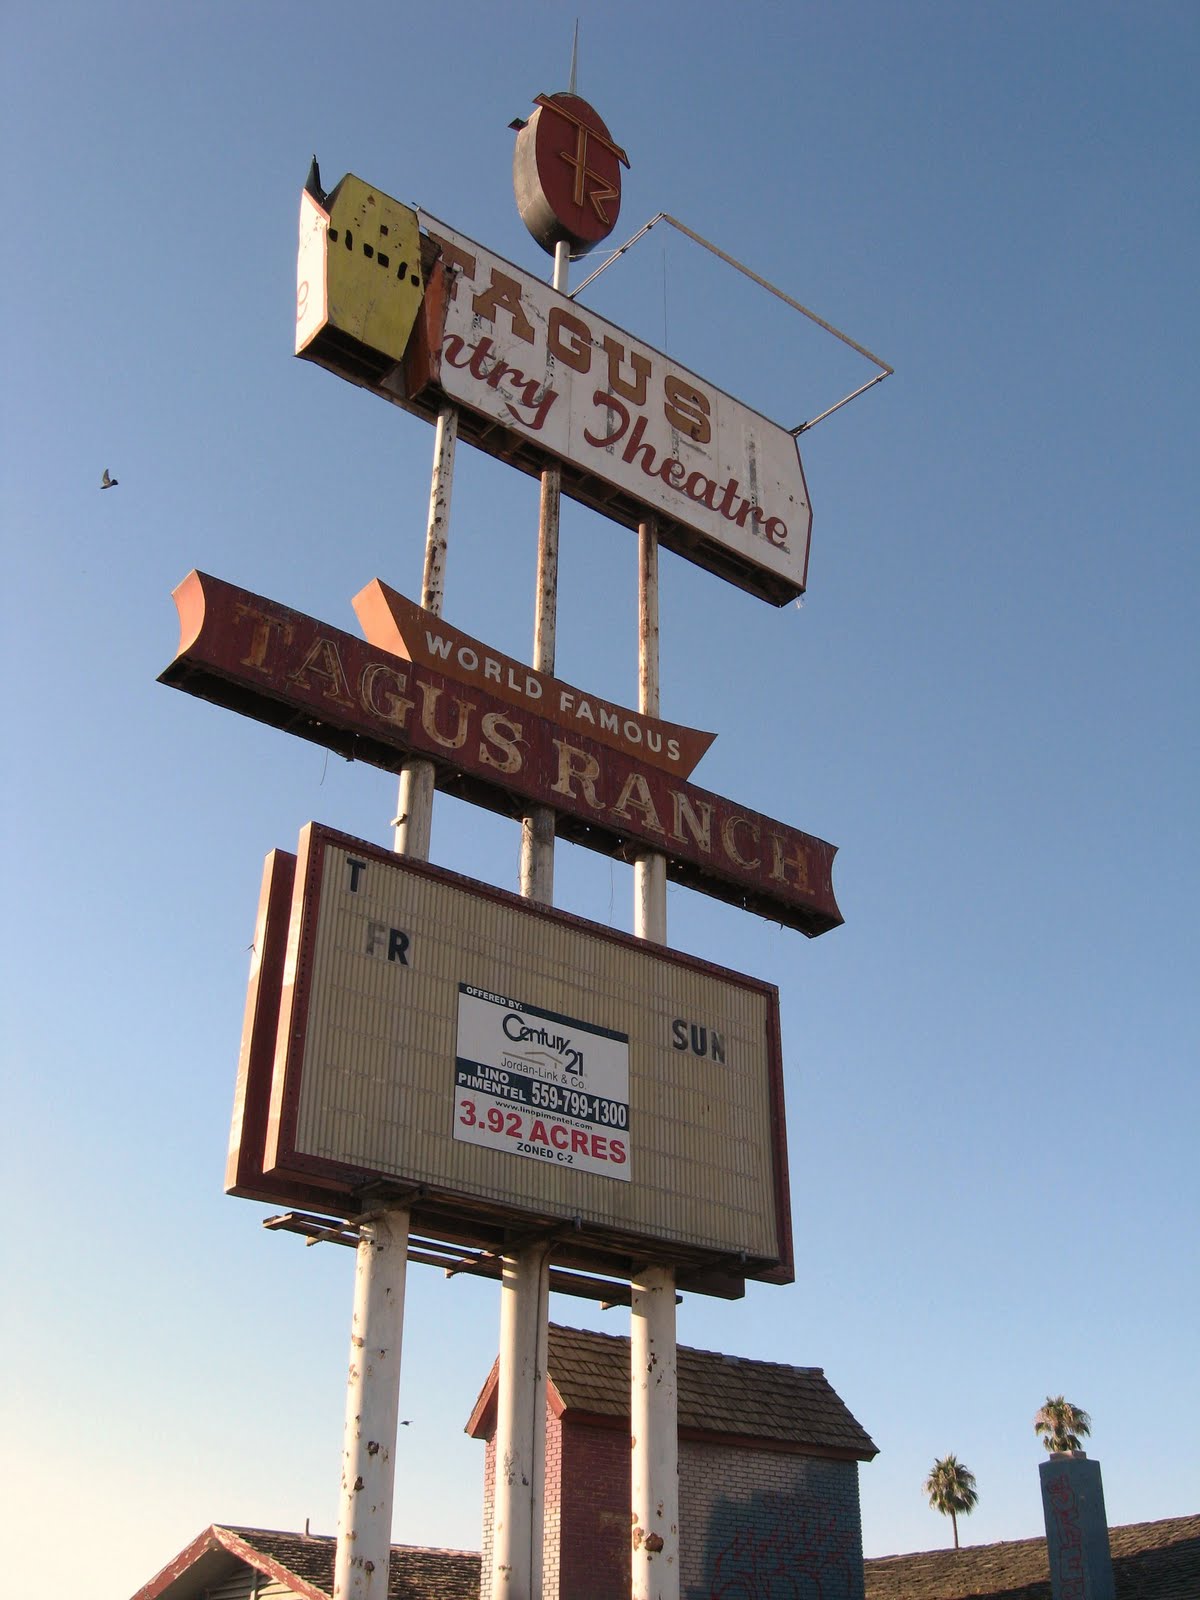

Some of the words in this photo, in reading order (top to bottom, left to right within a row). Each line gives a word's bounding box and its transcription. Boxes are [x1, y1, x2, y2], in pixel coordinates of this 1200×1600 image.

[584, 390, 788, 548] Theatre
[425, 631, 543, 699] WORLD
[560, 692, 681, 761] FAMOUS
[233, 602, 525, 775] TAGUS
[552, 739, 816, 896] RANCH
[346, 858, 366, 892] T
[466, 986, 506, 1005] OFFERED
[508, 998, 523, 1012] BY:
[502, 1013, 571, 1054] Century
[564, 1049, 584, 1077] 21
[672, 1019, 725, 1064] SUN
[477, 1065, 510, 1084] LINO
[501, 1057, 558, 1082] Jordan-Link
[561, 1074, 568, 1085] &
[571, 1079, 587, 1091] Co.
[458, 1073, 527, 1102] PIMENTEL
[531, 1081, 627, 1128] 559-799-1300
[495, 1100, 593, 1131] www.linopimentel.com
[459, 1100, 523, 1139] 3.92
[529, 1120, 627, 1164] ACRES
[517, 1142, 554, 1160] ZONED
[557, 1152, 574, 1164] C-2
